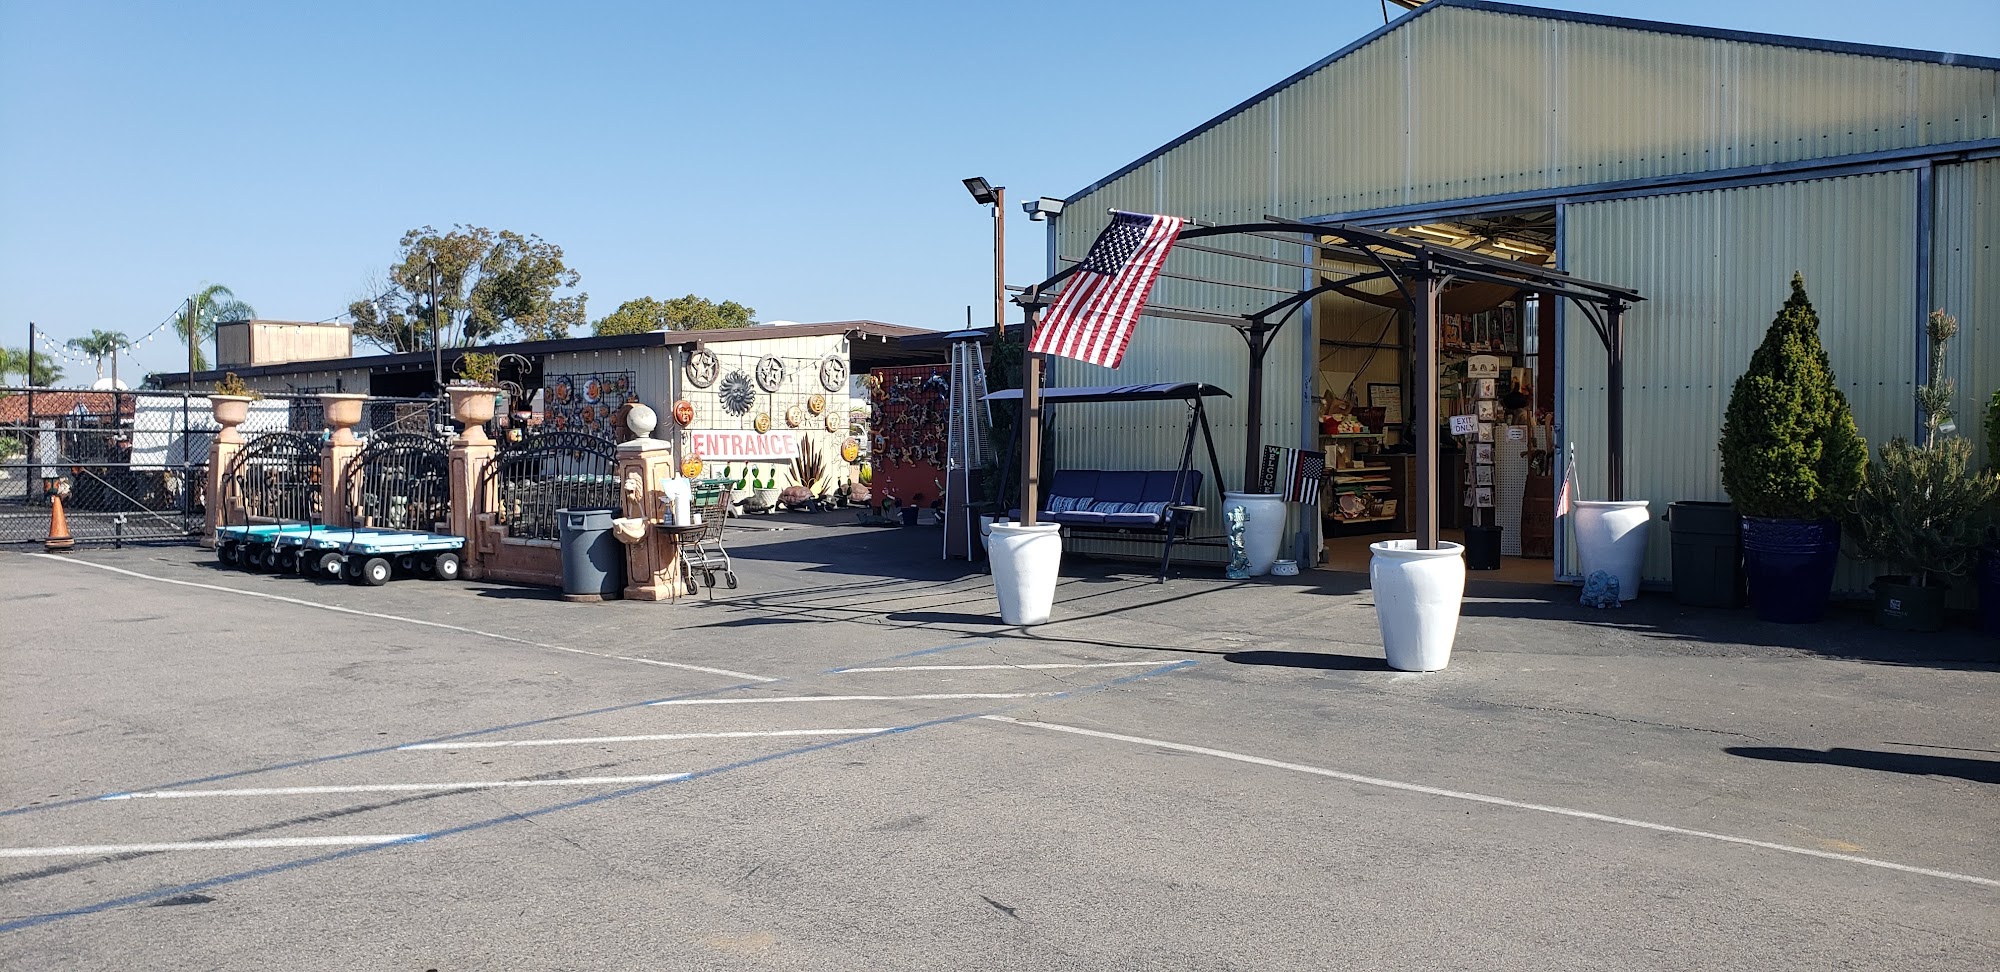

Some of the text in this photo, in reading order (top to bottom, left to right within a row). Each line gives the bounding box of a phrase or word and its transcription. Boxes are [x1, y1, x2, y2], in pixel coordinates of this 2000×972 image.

[1456, 416, 1472, 425] EXIT
[1455, 424, 1474, 433] ONLY
[693, 434, 796, 456] ENTRANCE
[1263, 446, 1279, 494] WELCOME
